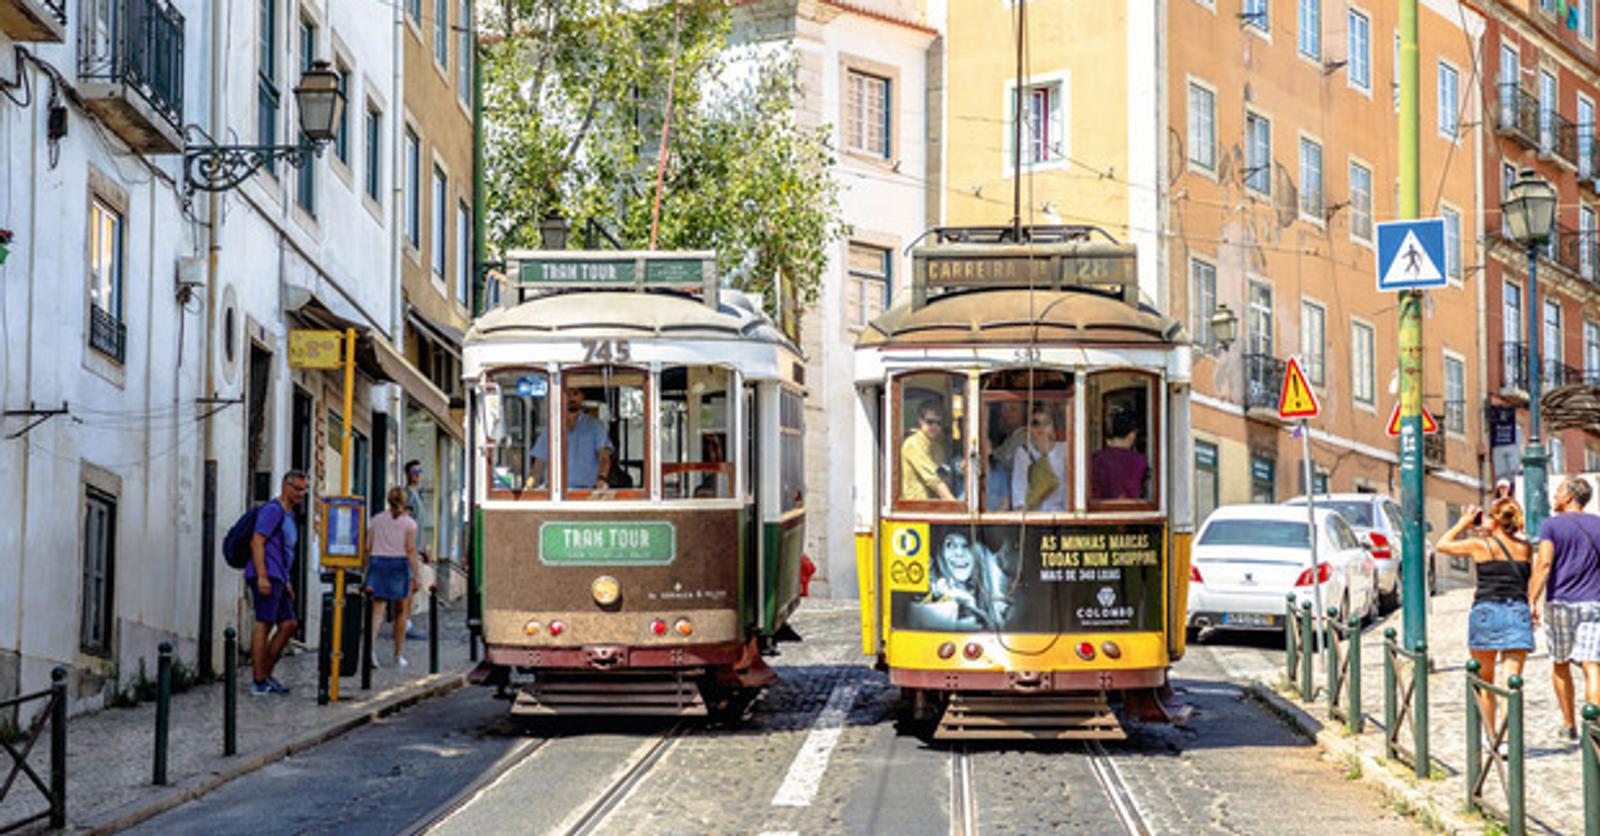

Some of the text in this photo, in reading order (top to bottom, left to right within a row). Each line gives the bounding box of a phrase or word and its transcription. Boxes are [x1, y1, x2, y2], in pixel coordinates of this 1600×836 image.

[580, 263, 618, 280] TOUR
[928, 260, 1016, 279] CARREIRA
[581, 338, 631, 362] 745
[563, 528, 651, 549] TRAM TOUR
[1041, 535, 1057, 550] AS
[1060, 534, 1106, 550] MINHAS
[1041, 552, 1079, 567] TODAS
[1083, 551, 1109, 567] NUM
[1076, 606, 1134, 618] COLOMBO
